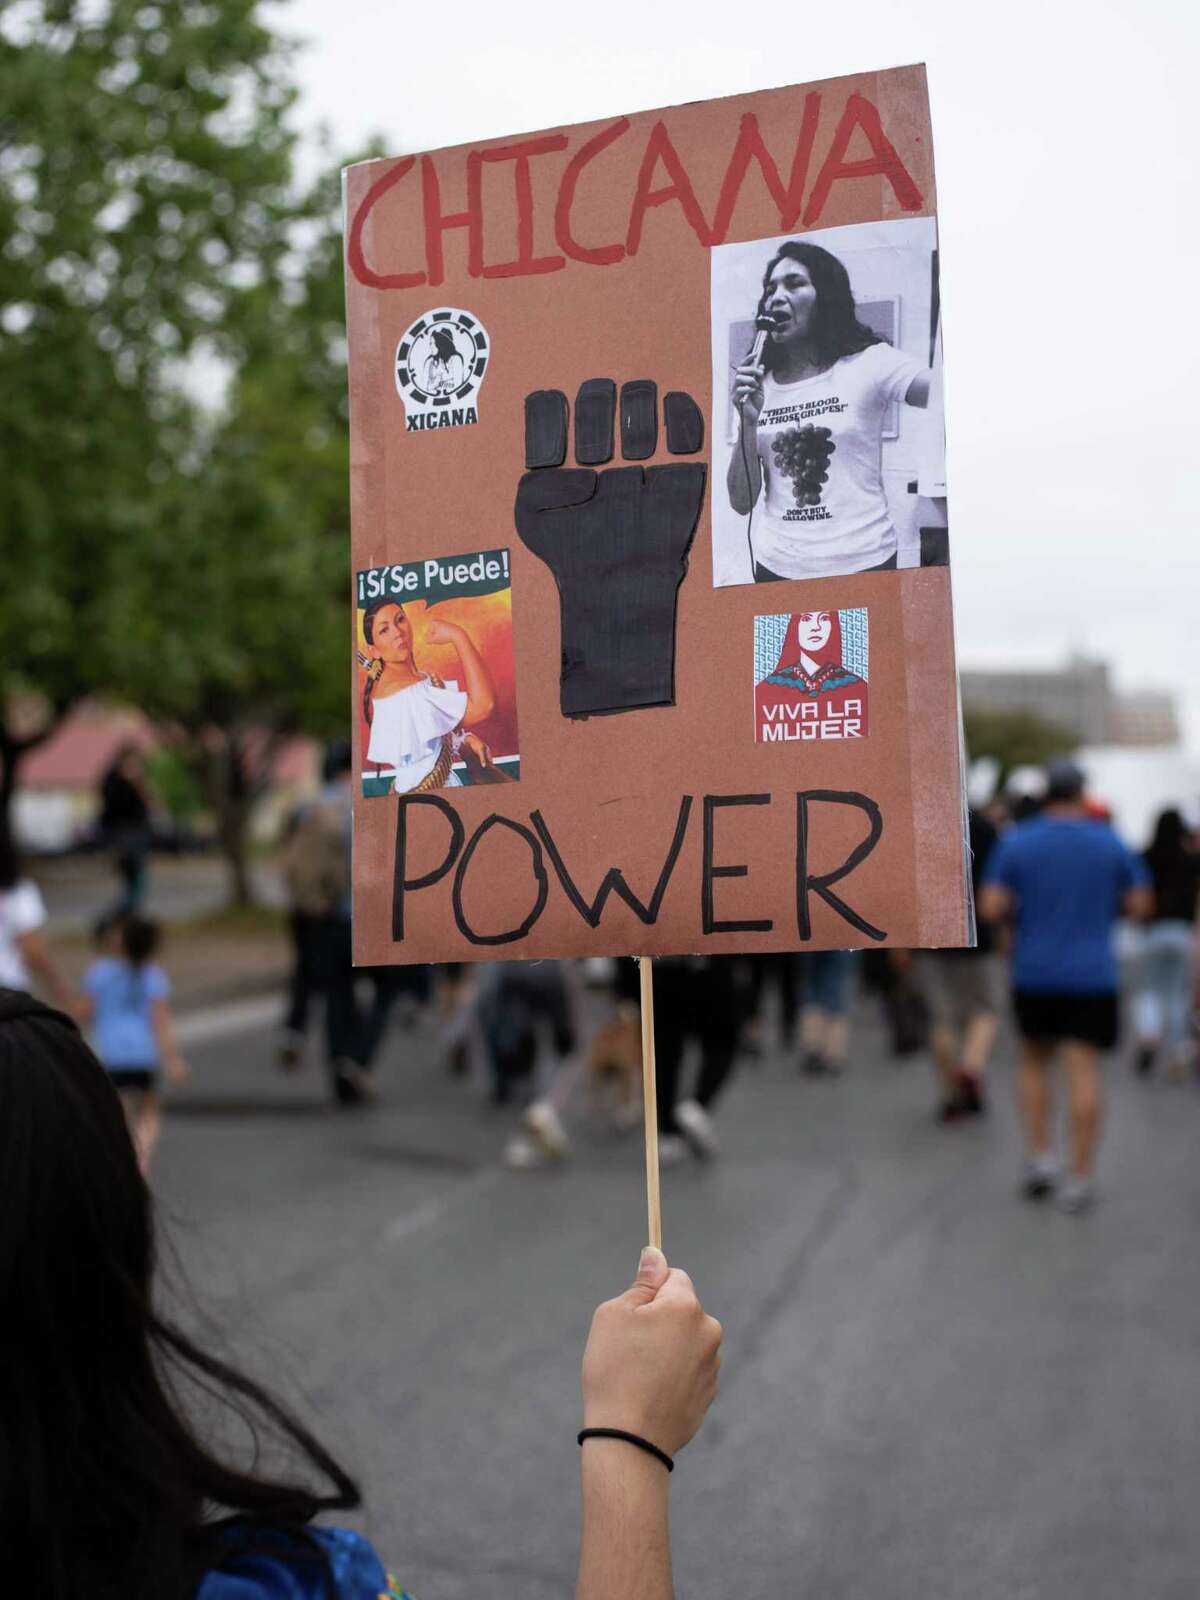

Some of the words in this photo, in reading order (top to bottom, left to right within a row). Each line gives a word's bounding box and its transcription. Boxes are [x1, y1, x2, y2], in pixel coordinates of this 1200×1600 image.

[347, 90, 923, 290] CHICANA
[769, 412, 800, 425] THOSE
[801, 404, 848, 419] GRAPES!"
[805, 397, 839, 409] BLOOD
[406, 407, 478, 432] XICANA
[810, 506, 826, 514] BUY
[359, 567, 390, 600] ¡Sí
[390, 565, 418, 593] Se
[424, 551, 510, 588] Puede!
[762, 702, 818, 720] VIVA
[827, 699, 862, 717] LA
[762, 718, 864, 742] MUJER
[392, 790, 888, 945] POWER
